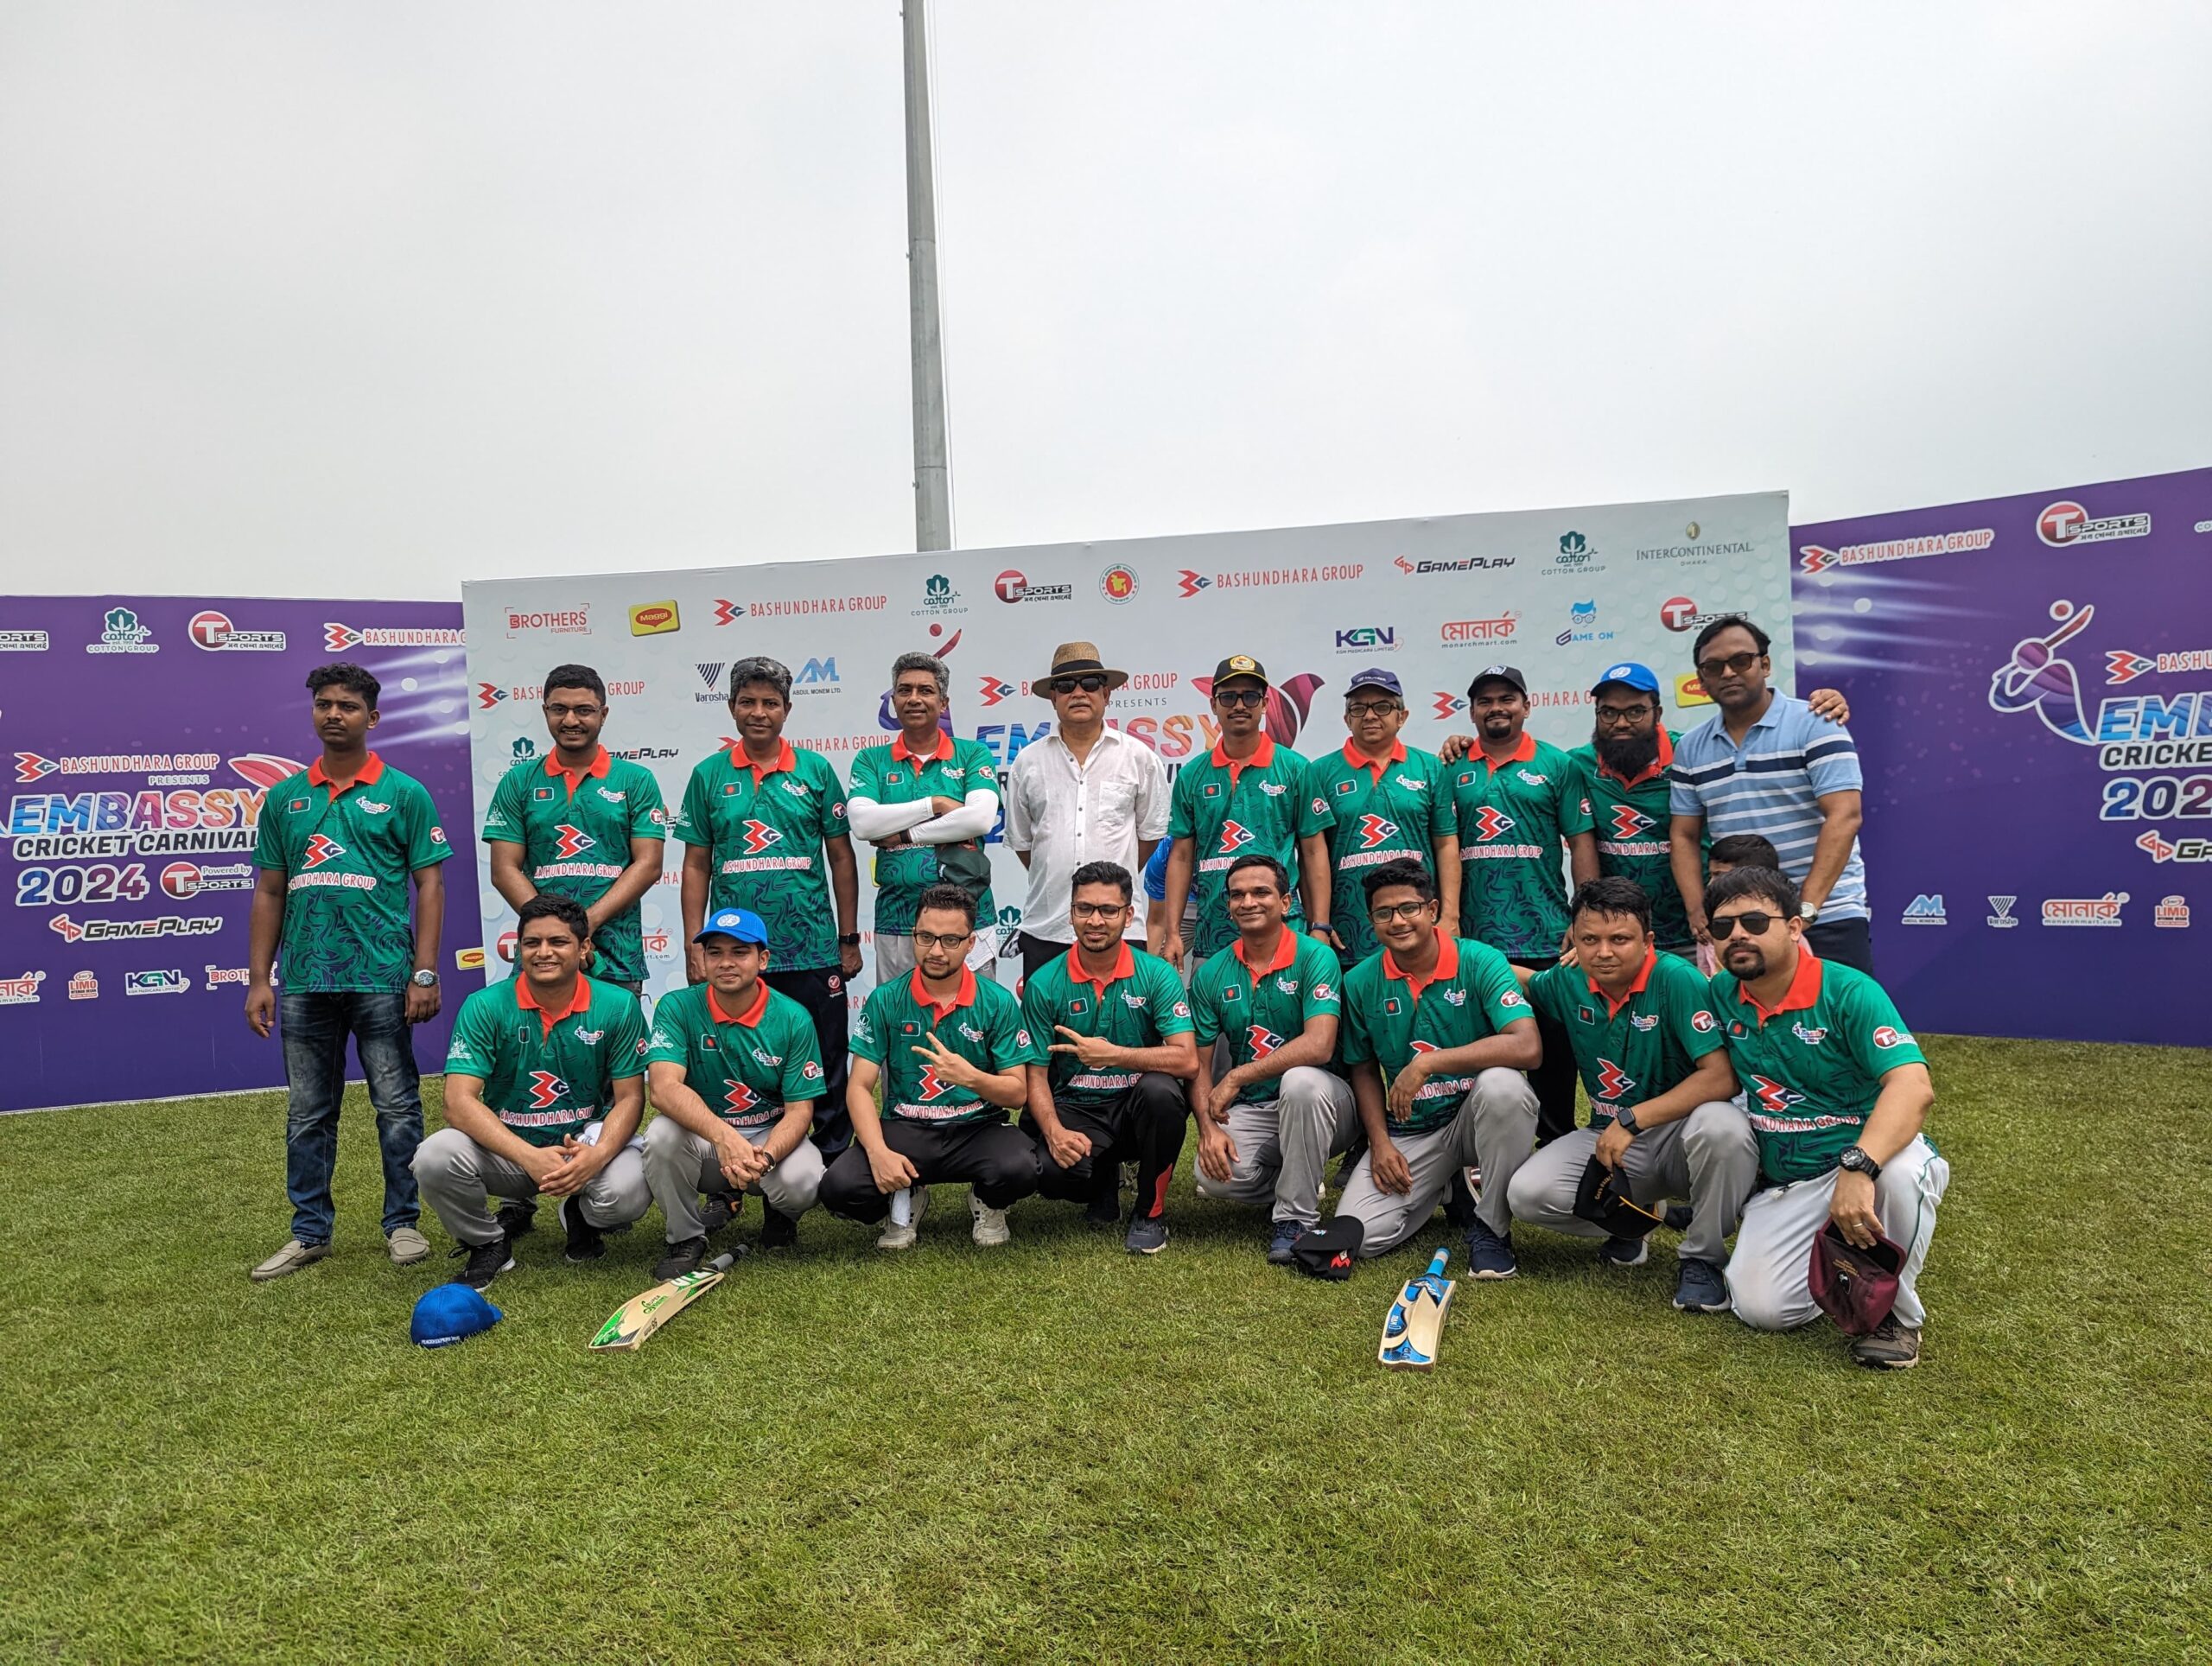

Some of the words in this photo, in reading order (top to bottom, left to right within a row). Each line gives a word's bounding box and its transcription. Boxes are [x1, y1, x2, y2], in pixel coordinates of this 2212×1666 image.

[2069, 517, 2147, 533] SPORTS
[1637, 543, 1754, 560] INTERCONTINENTAL
[1841, 538, 1943, 563] BASHUNDHARA
[1948, 531, 1992, 550] GROUP
[1217, 568, 1318, 588] BASHUNDHARA
[1322, 564, 1363, 581] GROUP
[1015, 585, 1071, 596] SPORTS
[751, 599, 845, 617] BASHUNDHARA
[849, 596, 887, 611] GROUP
[510, 612, 587, 629] BROTHERS
[639, 611, 669, 621] Maggi
[1441, 611, 1516, 640] মোনার্ক
[217, 633, 283, 642] SPORTS
[365, 631, 458, 645] BASHUNDHARA
[1336, 627, 1394, 647] KGN
[1441, 639, 1517, 648] monarchmart.com
[607, 682, 645, 696] GROUP
[1134, 673, 1178, 690] GROUP
[696, 691, 729, 703] Varosha
[1108, 697, 1167, 708] PRESENTS
[853, 734, 891, 750] GROUP
[2105, 742, 2212, 766] CRICKE
[60, 757, 172, 773] BASHUNDHARA
[175, 754, 219, 769] GROUP
[150, 775, 209, 785] PRESENTS
[2105, 780, 2212, 817] 202
[12, 790, 266, 834] EMBASSY
[17, 835, 131, 857] CRICKET
[203, 867, 238, 875] Powered
[239, 866, 251, 875] by
[785, 857, 811, 870] GROUP
[20, 867, 146, 904] 2024
[187, 879, 253, 890] SPORTS
[342, 874, 376, 889] GROUP
[2044, 893, 2120, 919] মোনার্ক
[2157, 907, 2187, 916] LIMO
[70, 981, 97, 989] LIMO
[127, 970, 180, 989] KGN
